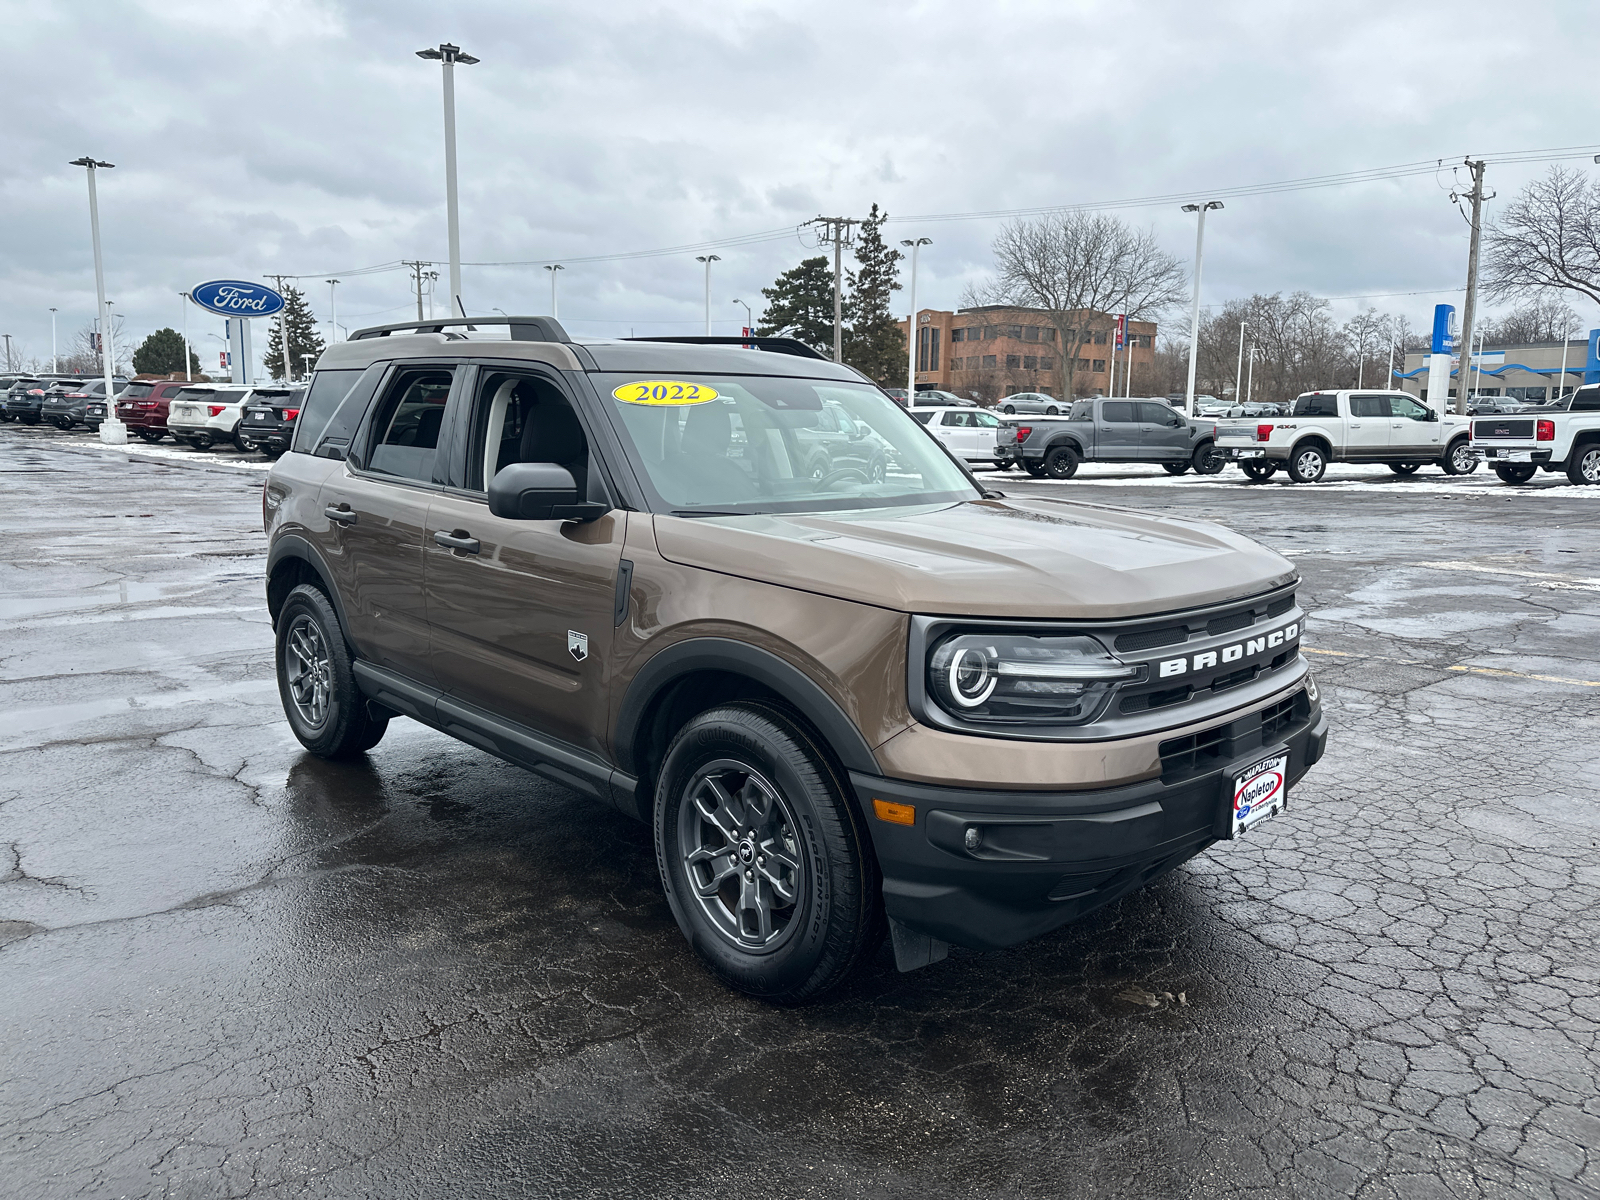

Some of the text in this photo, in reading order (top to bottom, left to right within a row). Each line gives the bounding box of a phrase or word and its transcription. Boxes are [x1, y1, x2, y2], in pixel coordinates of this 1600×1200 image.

[213, 286, 267, 310] Ford
[635, 385, 700, 401] 2022
[1159, 623, 1299, 678] BRONCO
[697, 726, 758, 749] Continental
[1246, 757, 1279, 780] NAPLETON
[1240, 780, 1275, 806] Napleton
